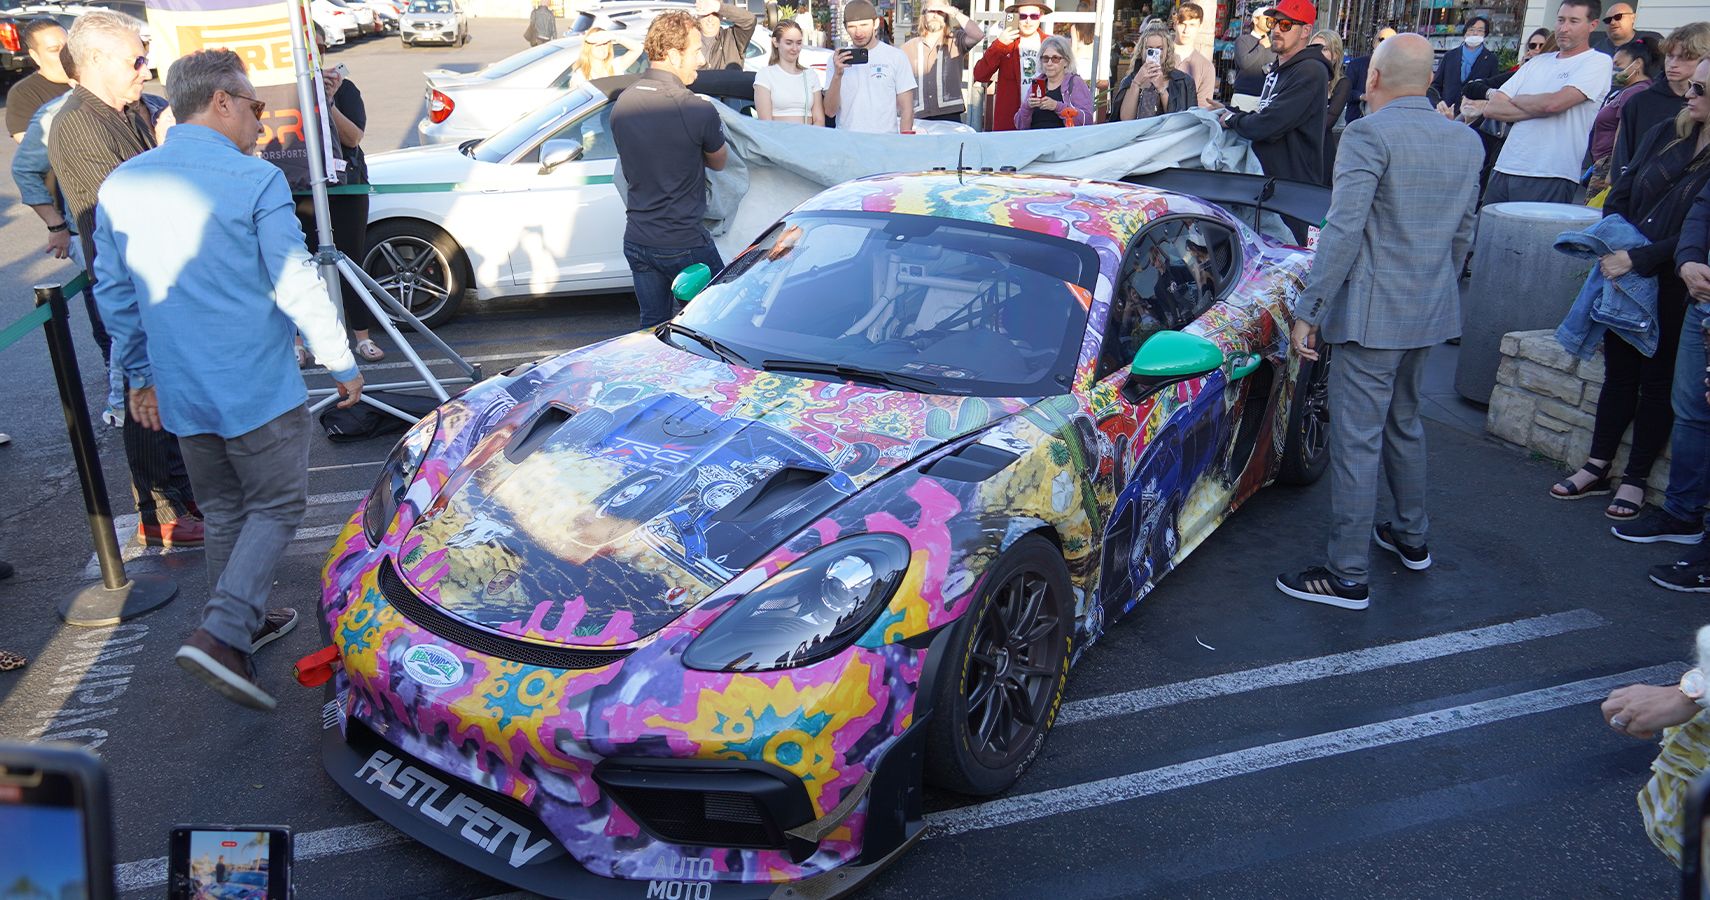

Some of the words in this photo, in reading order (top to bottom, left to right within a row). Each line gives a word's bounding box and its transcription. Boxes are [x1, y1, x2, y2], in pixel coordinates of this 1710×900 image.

[256, 149, 307, 159] TORSPORTS
[615, 436, 691, 463] TRG
[653, 855, 714, 880] AUTO
[646, 880, 712, 900] MOTO
